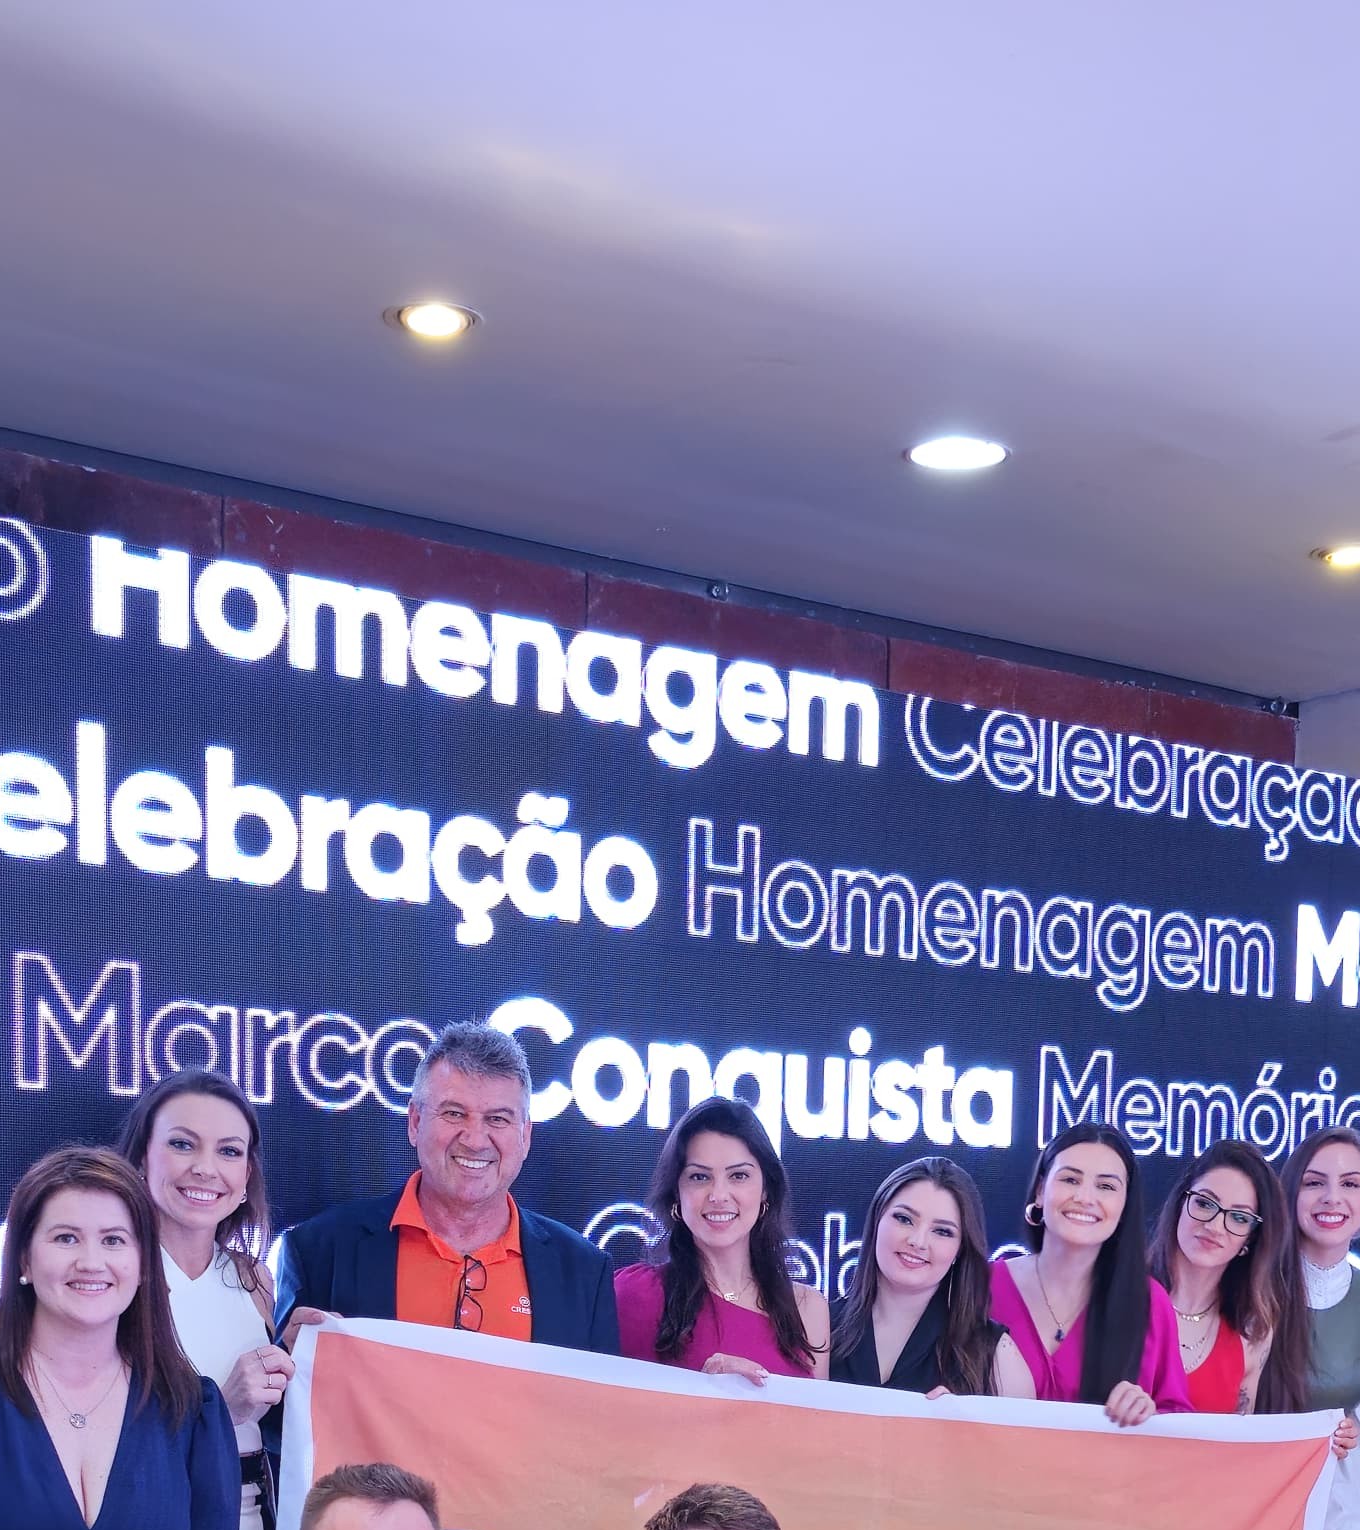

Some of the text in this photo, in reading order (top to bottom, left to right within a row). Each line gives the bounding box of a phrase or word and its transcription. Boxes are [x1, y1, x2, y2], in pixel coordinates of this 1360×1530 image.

[89, 533, 880, 770] Homenagem
[687, 818, 1274, 1011] Homenagem
[13, 951, 439, 1115] Marco
[490, 997, 1014, 1159] Conquista
